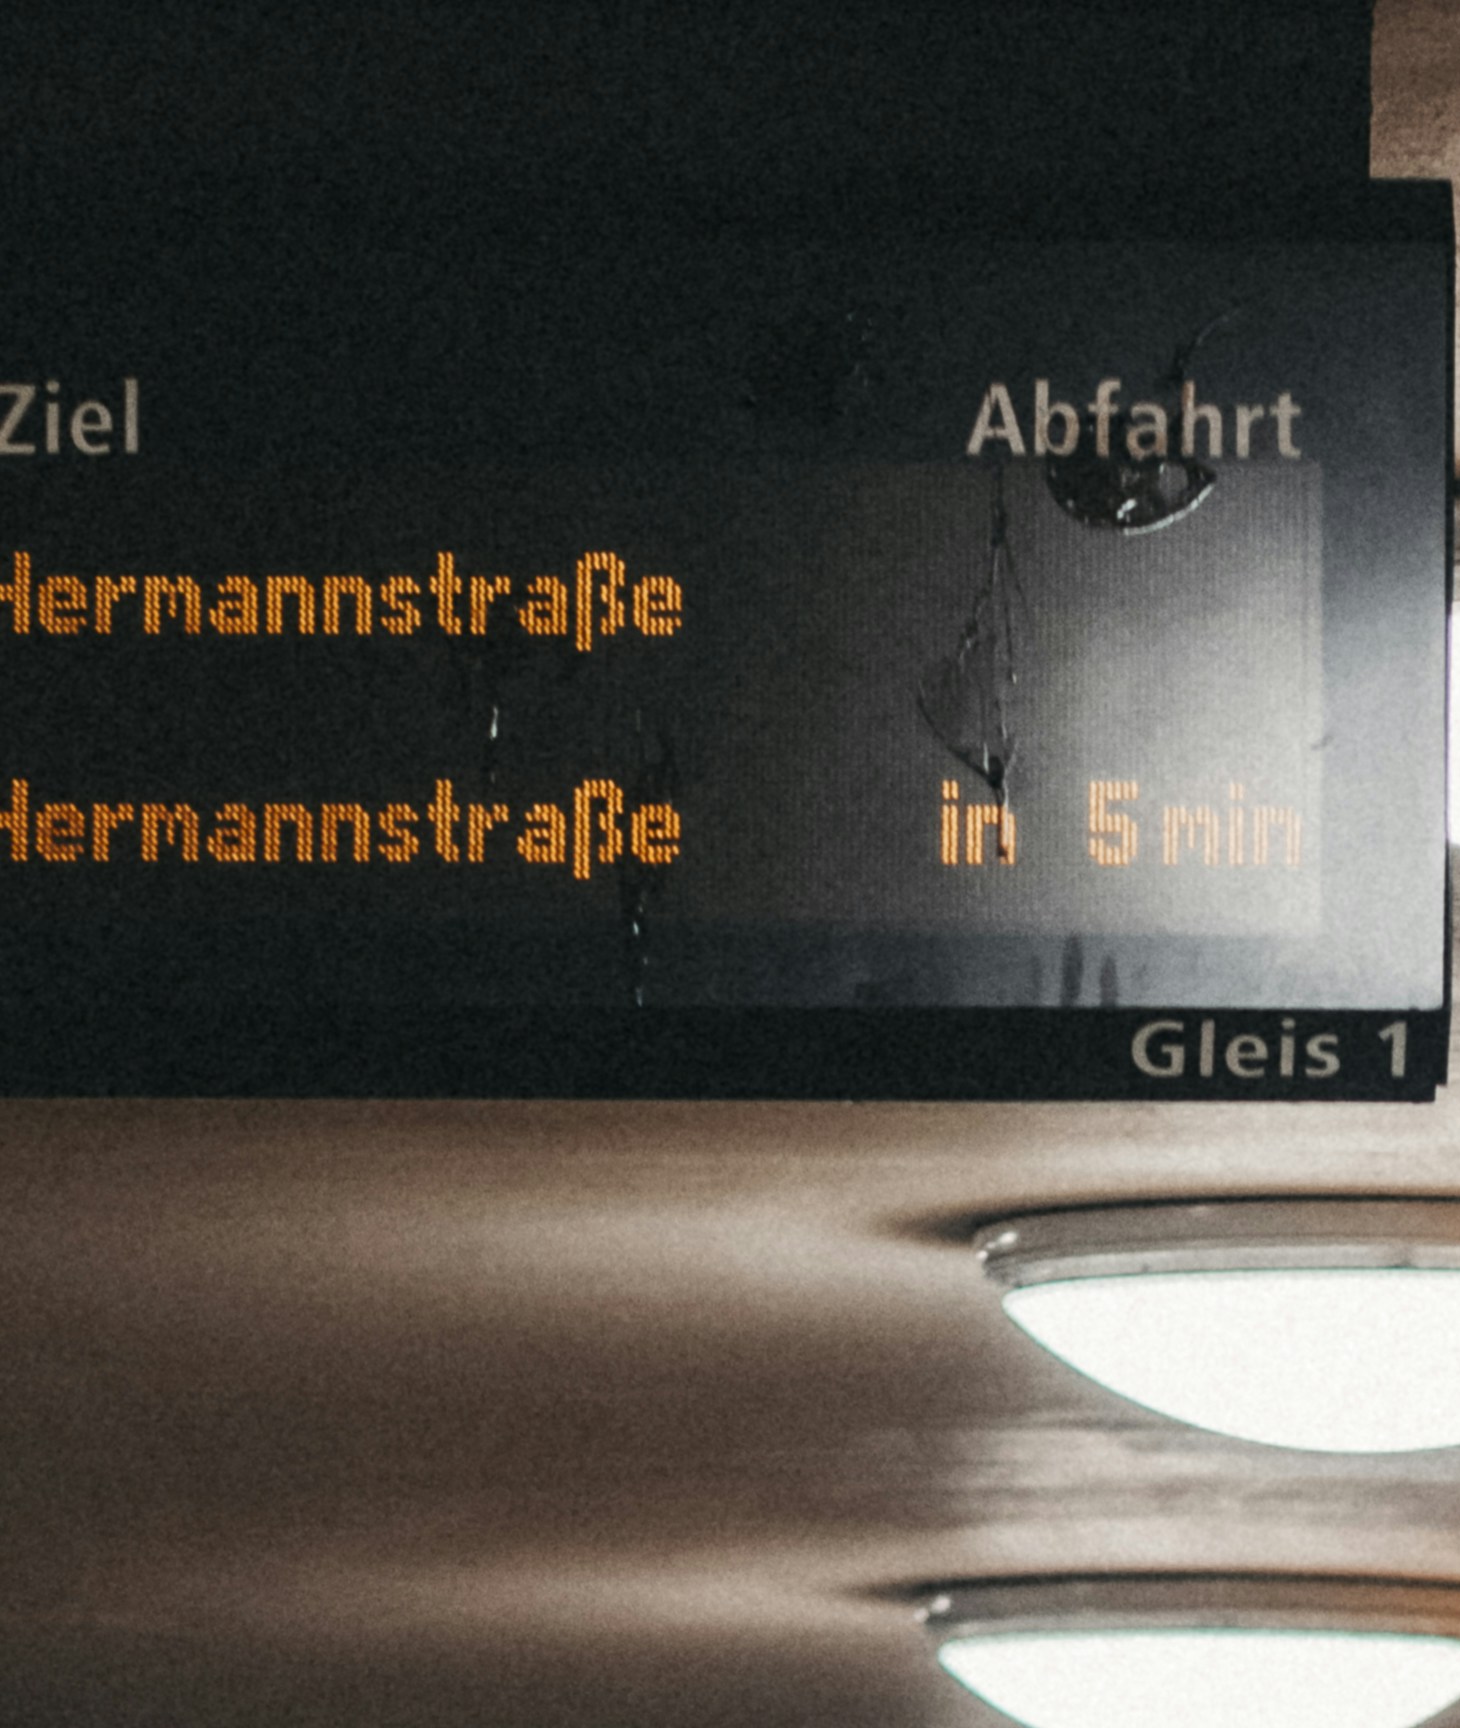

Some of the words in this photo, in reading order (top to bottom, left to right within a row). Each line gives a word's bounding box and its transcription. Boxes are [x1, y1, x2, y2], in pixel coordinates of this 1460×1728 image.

[0, 379, 140, 455] Ziel
[967, 380, 1301, 458] Abfahrt
[940, 780, 1016, 866] in
[1088, 780, 1139, 866] 5
[1162, 780, 1301, 866] min
[1131, 1018, 1340, 1078] Gleis
[1377, 1021, 1407, 1078] 1
